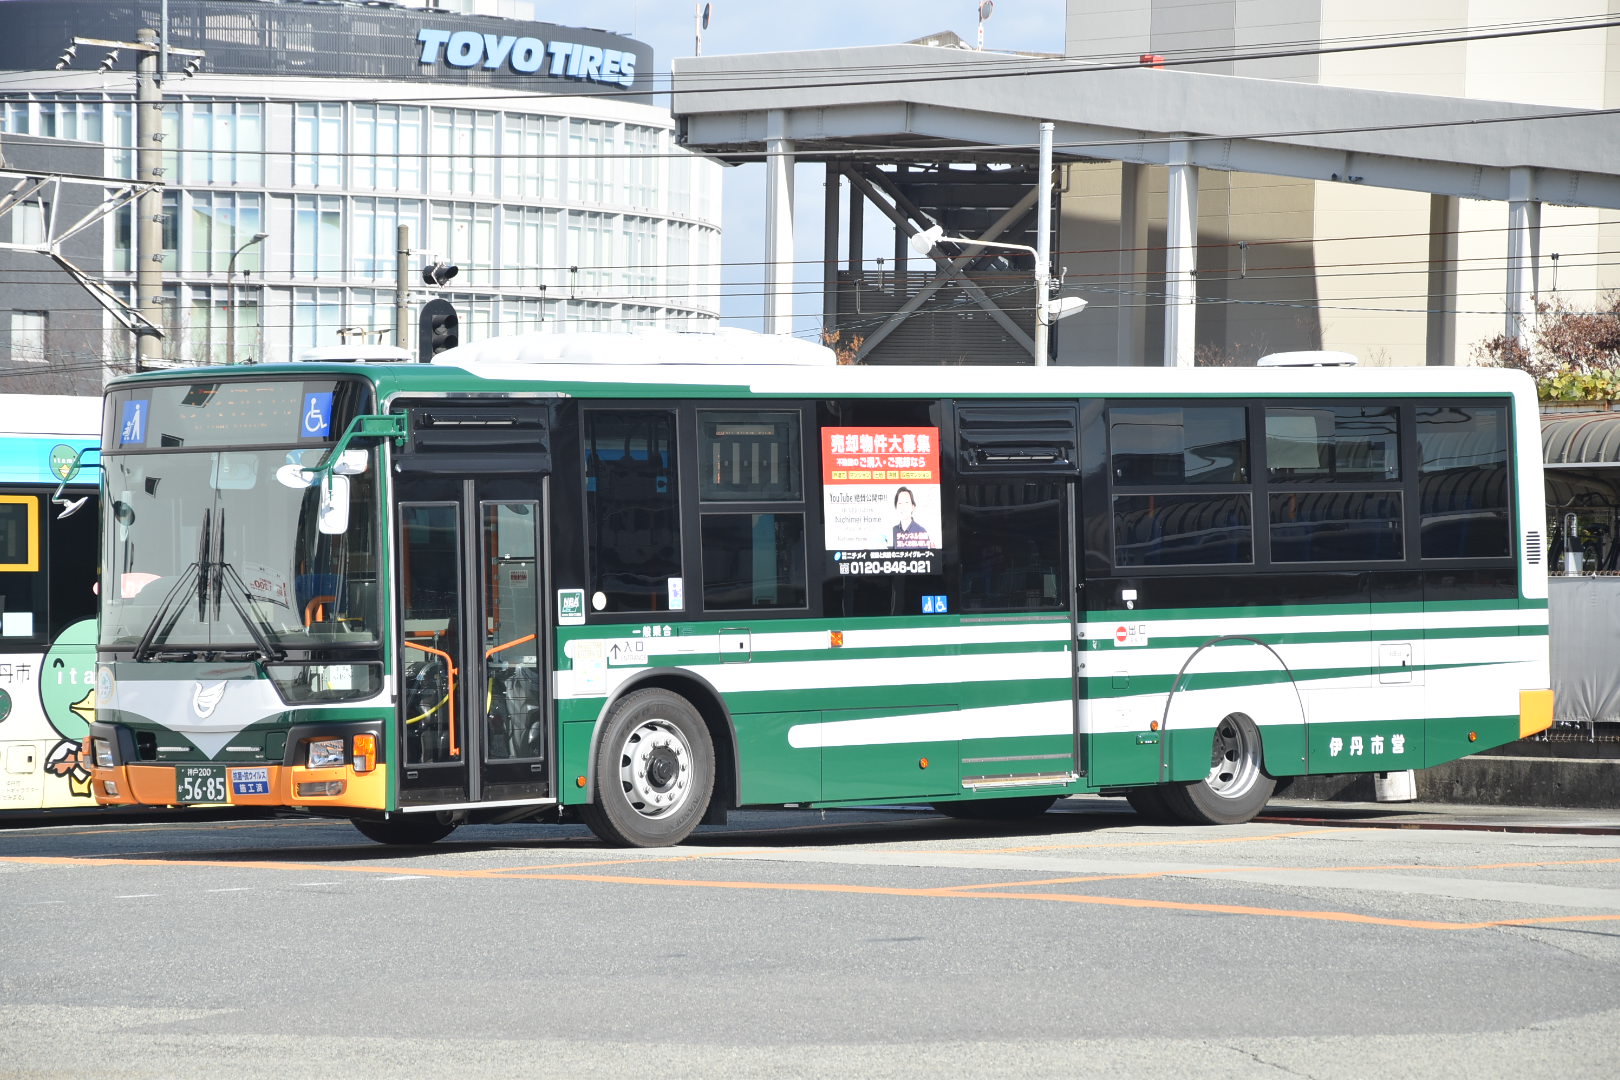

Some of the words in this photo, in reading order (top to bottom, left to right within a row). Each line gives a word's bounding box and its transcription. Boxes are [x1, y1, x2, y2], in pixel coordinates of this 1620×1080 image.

[417, 28, 545, 73] TOYO
[547, 40, 637, 87] TIRES
[830, 434, 931, 453] 売却物件大募集
[829, 493, 853, 503] YouTube
[863, 516, 882, 524] Home
[850, 560, 931, 575] 0120-846-021
[1128, 624, 1146, 636] 出口
[623, 641, 644, 653] 入口
[1329, 734, 1405, 757] 伊丹市営
[184, 777, 225, 801] 56-85
[239, 783, 264, 793] 施工済
